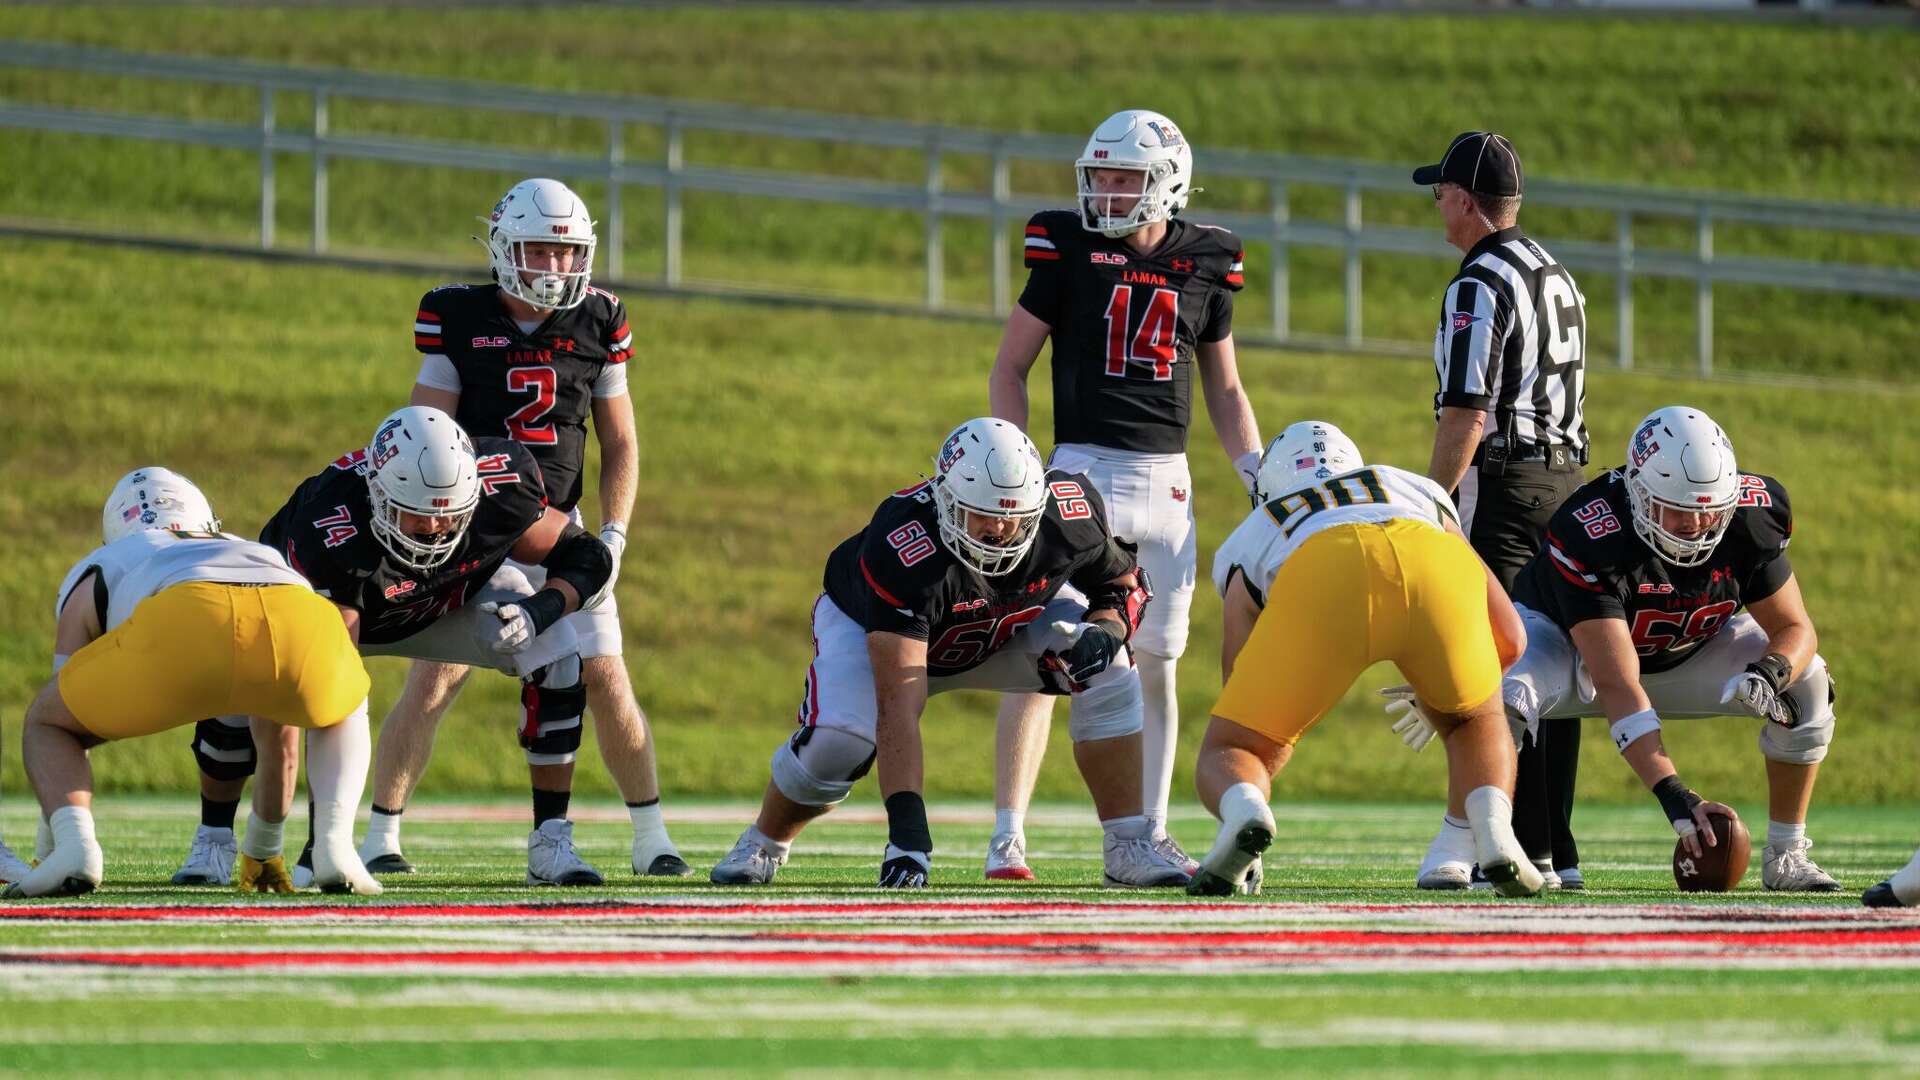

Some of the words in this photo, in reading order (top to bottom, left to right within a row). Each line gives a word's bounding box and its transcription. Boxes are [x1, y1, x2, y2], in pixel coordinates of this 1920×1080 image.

[1123, 271, 1167, 286] LAMAR
[1103, 284, 1180, 381] 14
[503, 366, 557, 445] 2
[1313, 441, 1326, 453] 90
[1556, 450, 1565, 466] S
[475, 453, 521, 497] 74
[1049, 481, 1092, 520] 60
[1263, 469, 1391, 540] 90
[1572, 498, 1621, 539] 58
[312, 504, 358, 549] 74
[886, 520, 937, 568] 60
